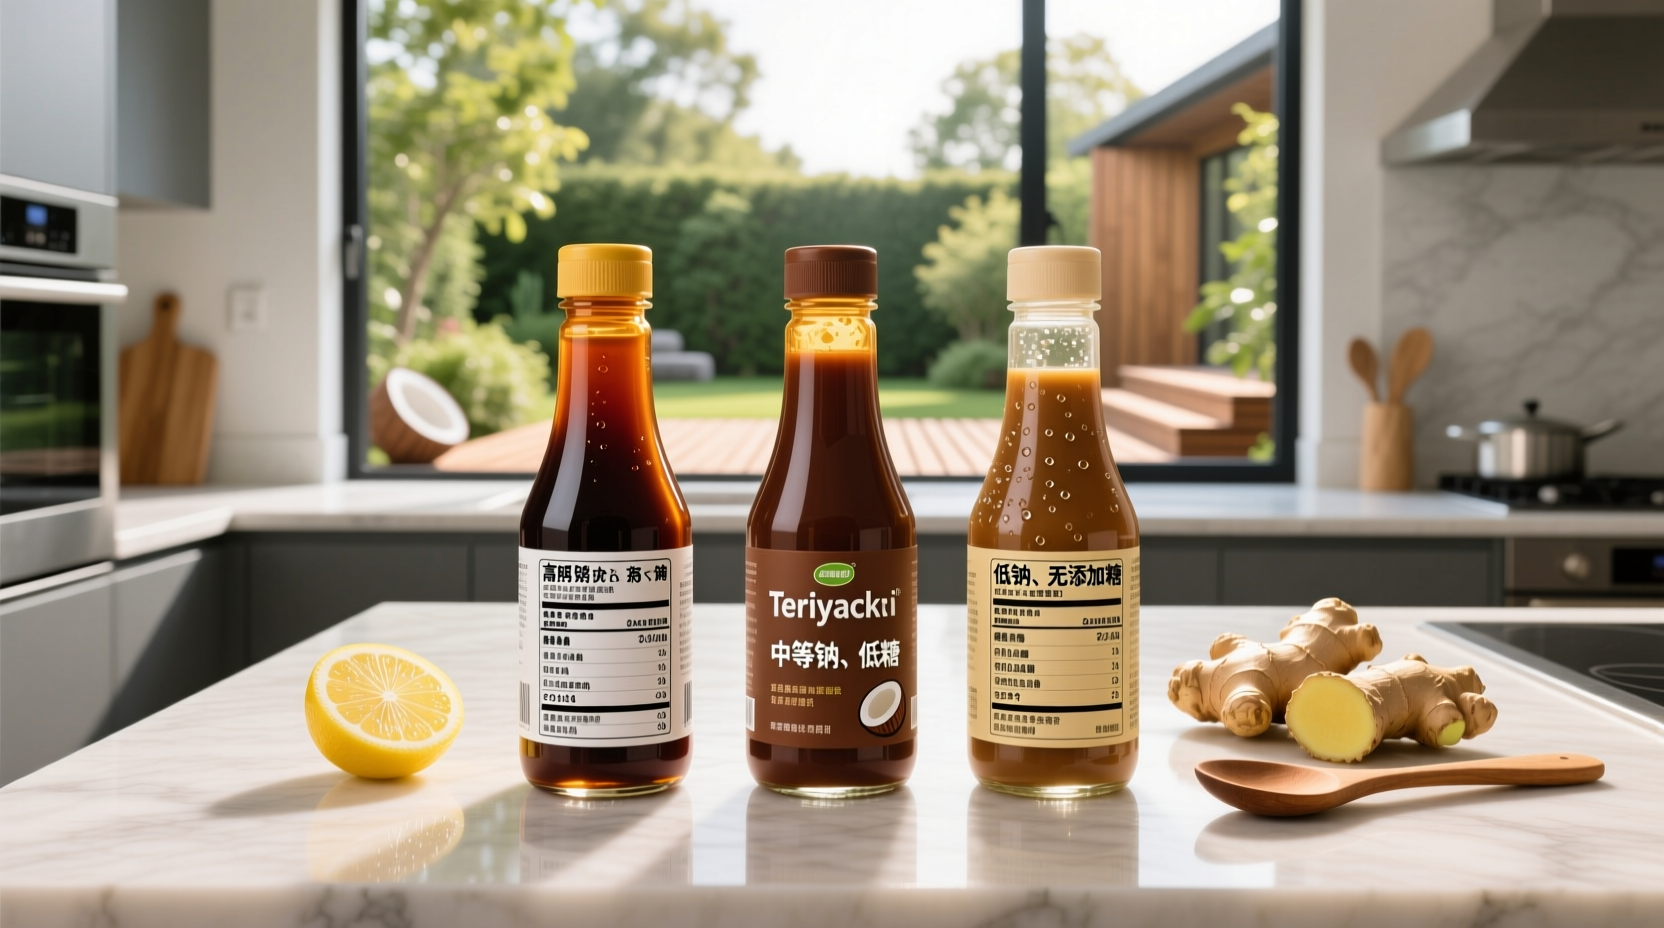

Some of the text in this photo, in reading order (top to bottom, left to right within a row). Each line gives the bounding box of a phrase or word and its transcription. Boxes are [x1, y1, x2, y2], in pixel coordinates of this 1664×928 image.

[993, 563, 1121, 587] 低钠、无添加糖
[771, 639, 900, 669] 中等钠、低糖
